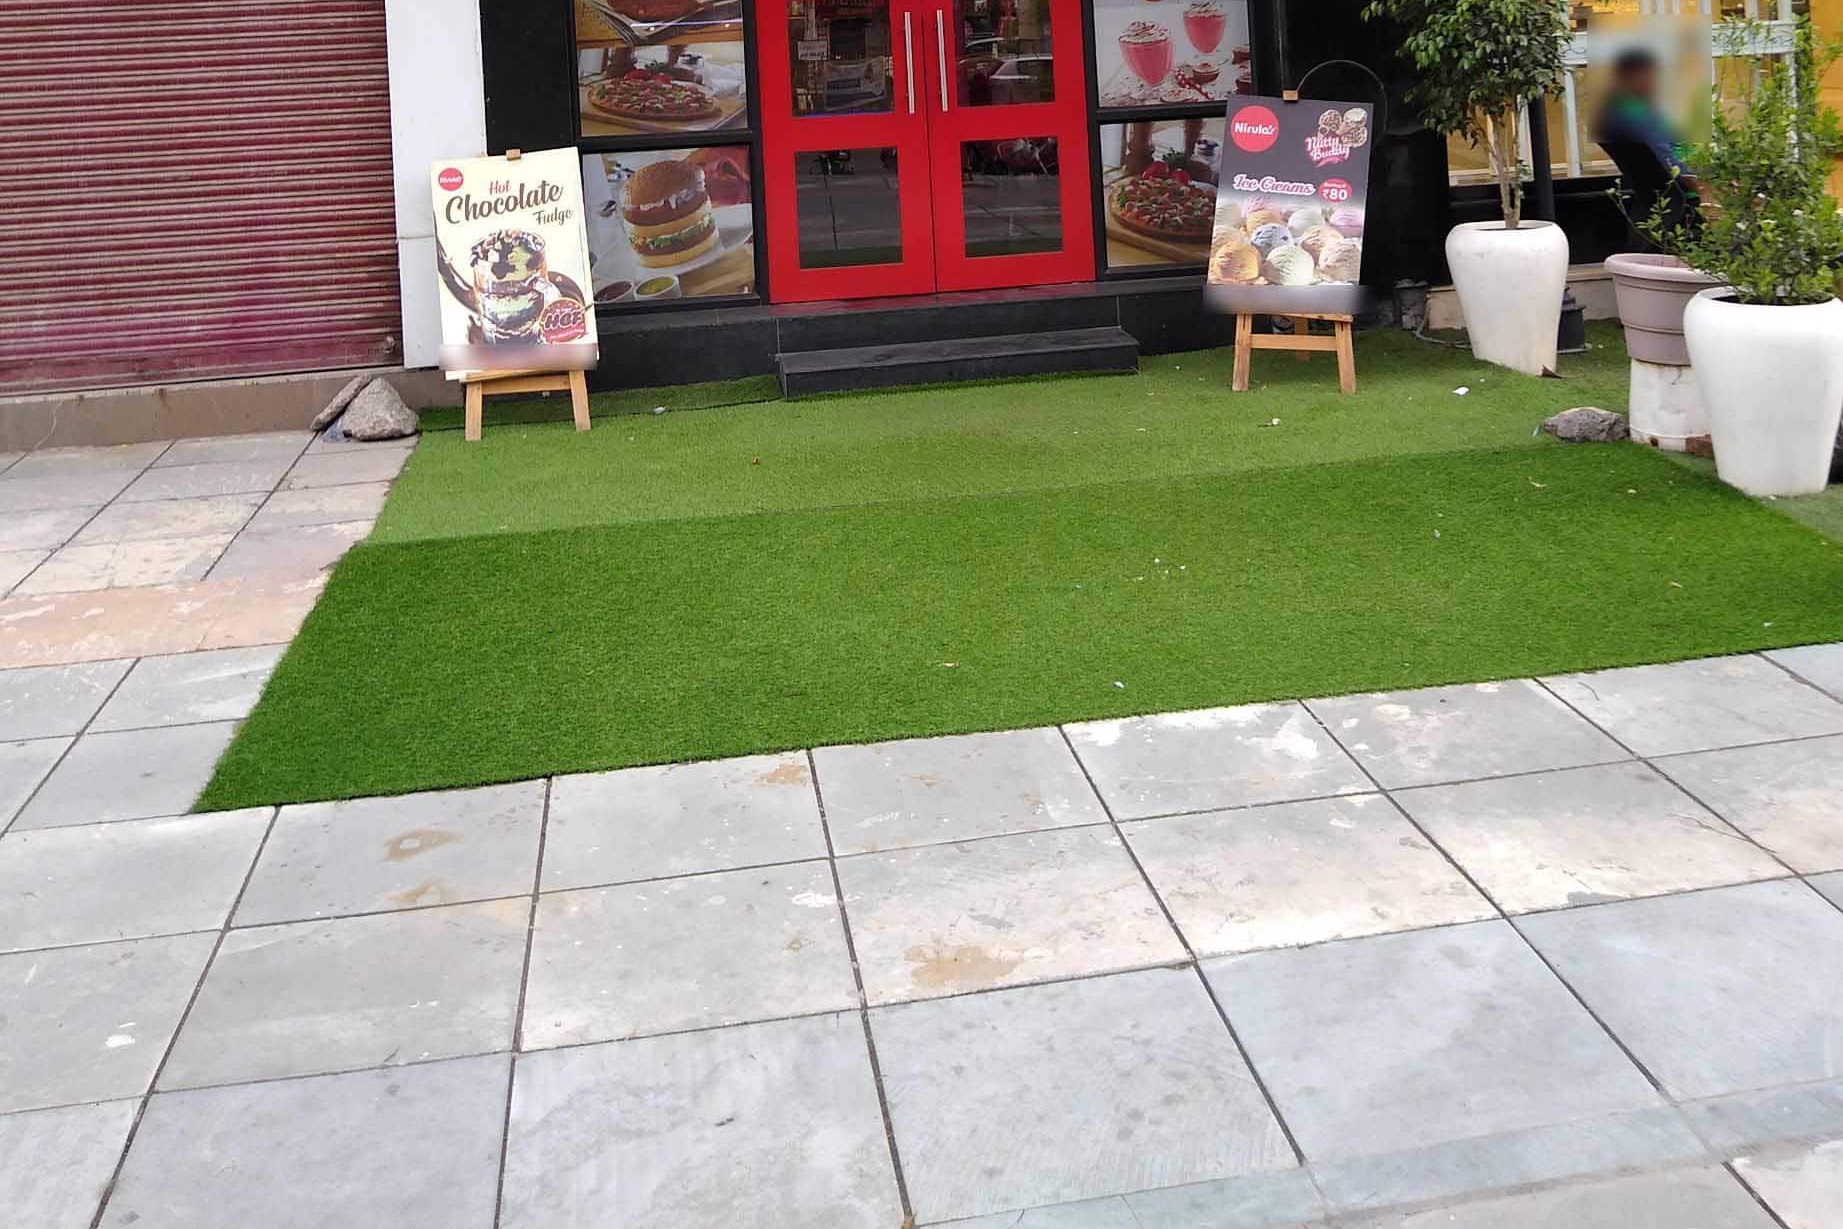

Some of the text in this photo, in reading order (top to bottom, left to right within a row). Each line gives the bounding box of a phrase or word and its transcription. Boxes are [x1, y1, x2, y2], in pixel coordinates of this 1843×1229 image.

[489, 180, 511, 195] Hot
[1233, 174, 1316, 195] Ice Creams
[446, 180, 564, 224] Chocolate
[533, 207, 574, 226] Fudge
